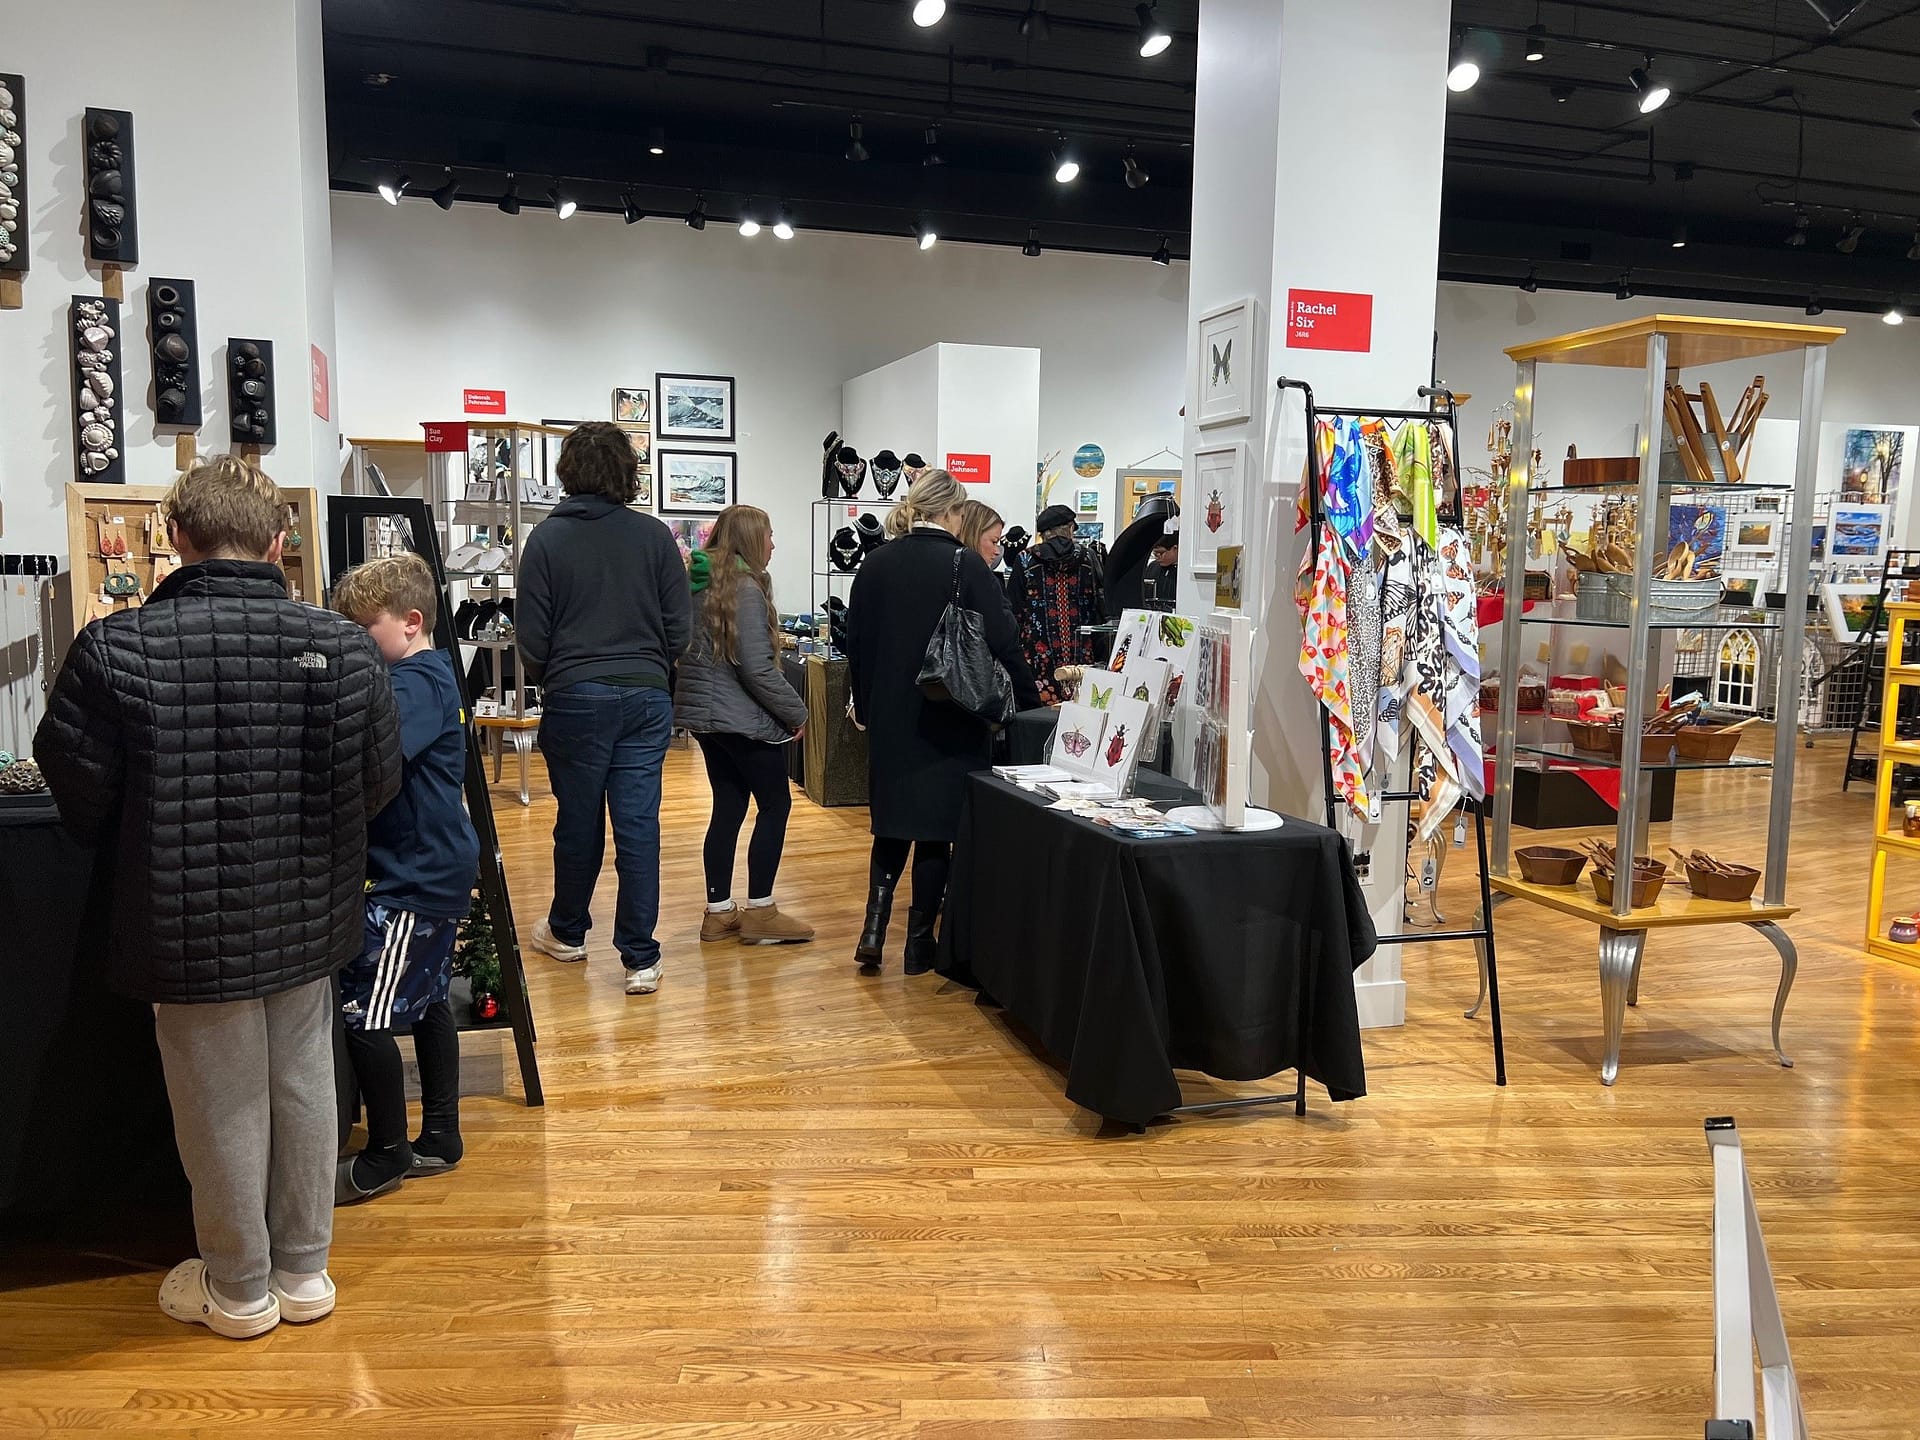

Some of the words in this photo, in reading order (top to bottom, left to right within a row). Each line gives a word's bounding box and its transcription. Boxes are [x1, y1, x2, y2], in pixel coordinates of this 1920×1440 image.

[1296, 301, 1337, 315] Rachel
[1296, 316, 1314, 328] Six
[429, 435, 444, 443] Clay
[951, 459, 967, 467] Amy
